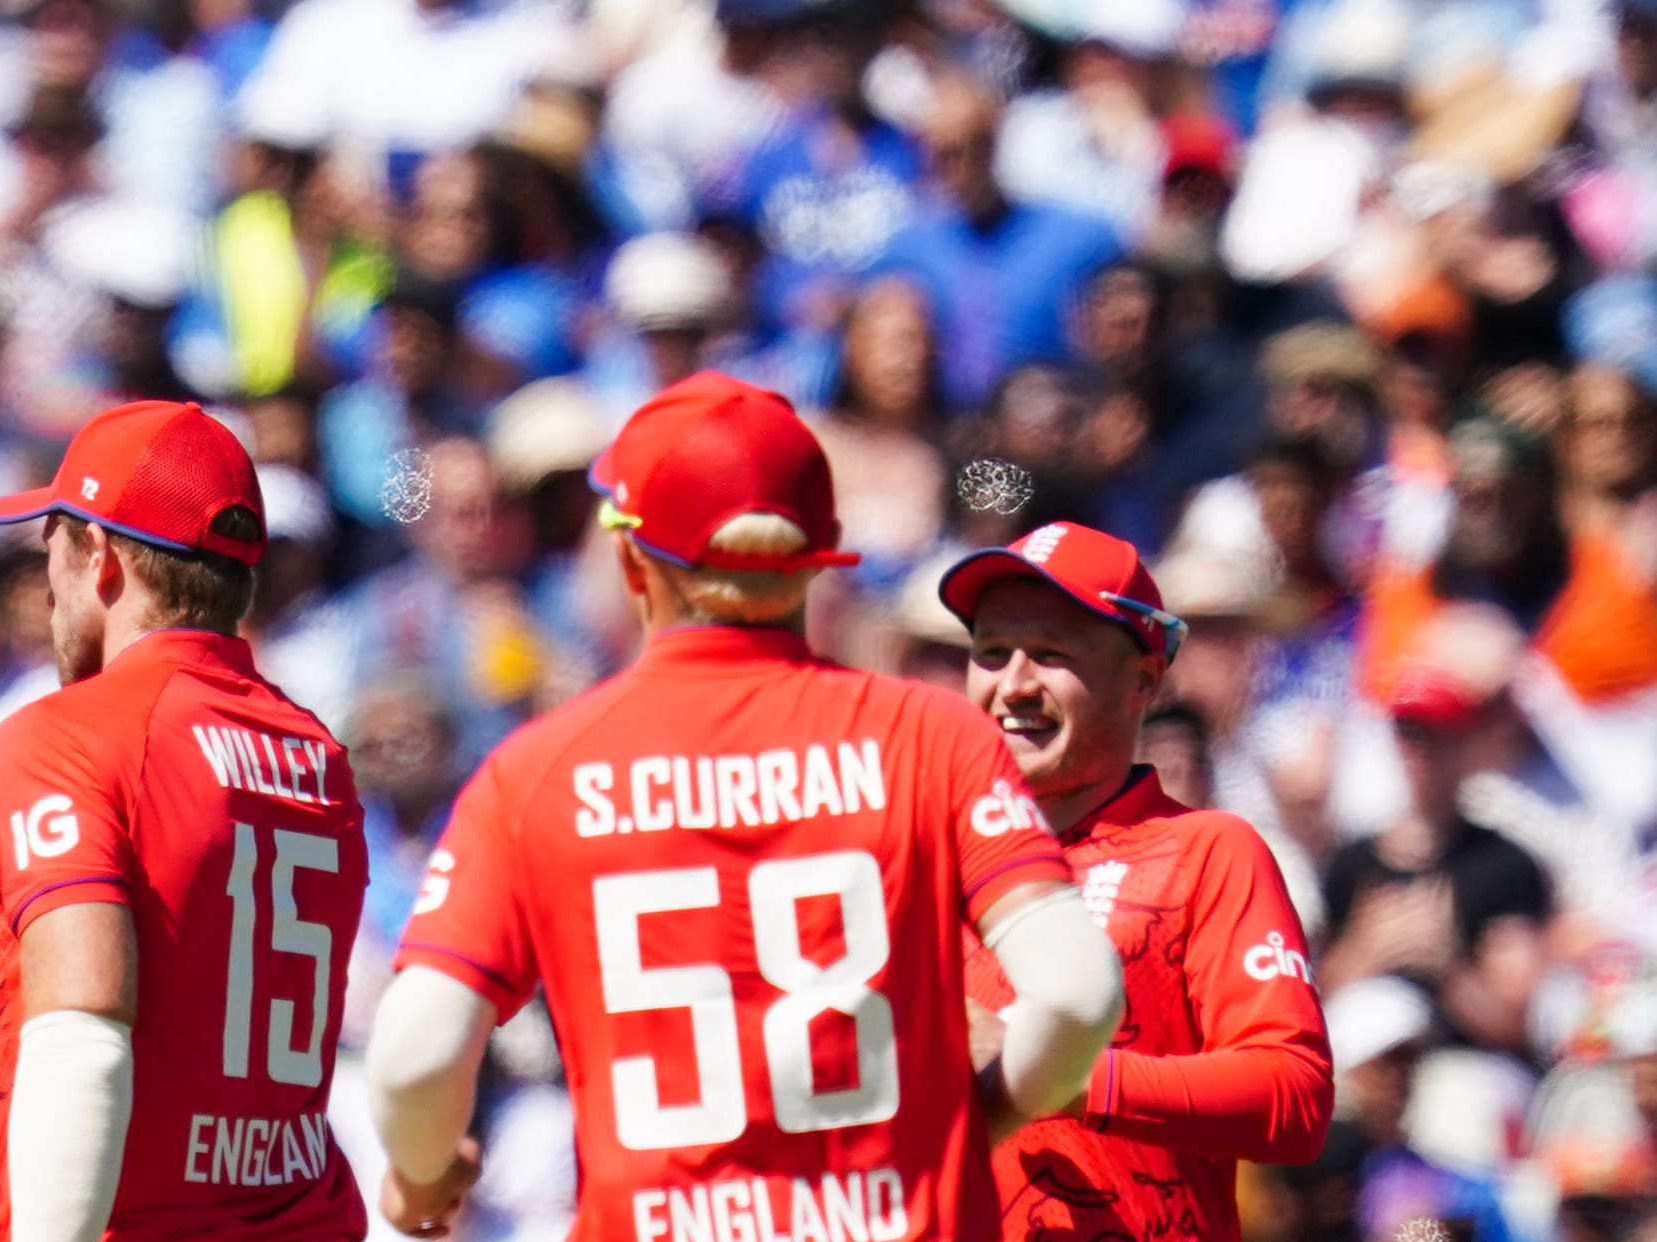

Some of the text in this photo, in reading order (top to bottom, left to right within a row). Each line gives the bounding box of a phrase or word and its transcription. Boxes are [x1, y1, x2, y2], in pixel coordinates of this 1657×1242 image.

[192, 725, 329, 806] WILLEY
[573, 739, 886, 838] S.CURRAN
[10, 794, 79, 870] IG
[223, 822, 339, 1088] 15
[1244, 931, 1315, 983] cin
[592, 848, 901, 1151] 58
[185, 1113, 328, 1187] ENGLAN
